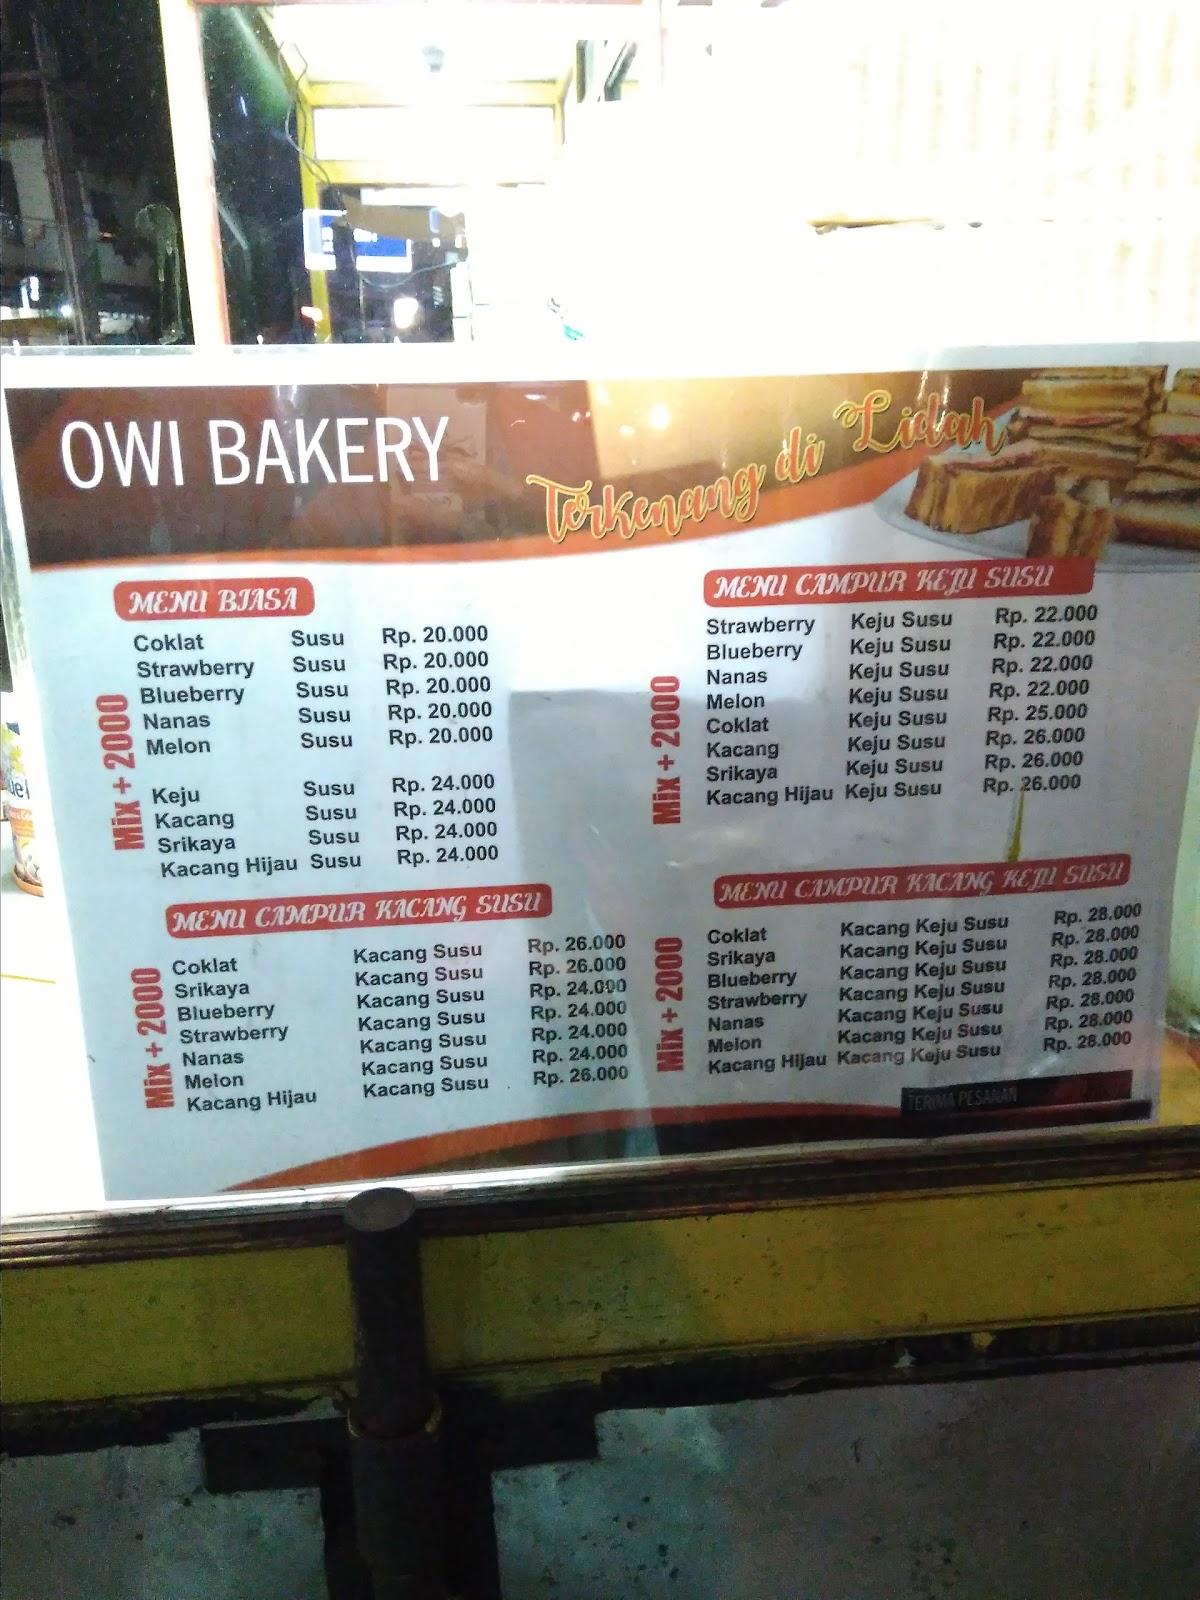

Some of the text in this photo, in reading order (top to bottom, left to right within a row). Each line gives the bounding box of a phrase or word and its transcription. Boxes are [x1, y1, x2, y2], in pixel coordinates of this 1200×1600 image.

[62, 416, 449, 488] OWI BAKERY
[526, 390, 1008, 542] Terkenang di Lidah
[714, 565, 1055, 599] MENU CAMPUR KEJU SUSU
[129, 588, 298, 614] MENU BIASA
[133, 625, 488, 652] Coklat Susu Rp. 20.000
[706, 604, 1098, 636] Strawberry Keju Susu Rp. 22.000
[707, 629, 1096, 662] Blueberry Keju Susu Rp. 22.000
[136, 650, 489, 680] Strawberry Susu Rp. 20.000
[707, 654, 1093, 685] Nanas Keju Susu Rp. 22.000
[140, 675, 491, 706] Blueberry Susu Rp. 20.000
[706, 679, 1090, 710] Melon Keju Susu Rp. 22.000
[143, 701, 492, 730] Nanas Susu Rp. 20.000
[651, 676, 680, 747] 2000
[706, 702, 1088, 734] Coklat Keju Susu Rp. 25.000
[96, 694, 136, 770] 2000
[146, 726, 493, 756] Melon Susu Rp. 20.000
[706, 727, 1086, 760] Kacang Keju Susu Rp. 26.000
[706, 750, 1084, 784] Srikaya Keju Susu Rp. 26.000
[152, 773, 495, 808] Keju Susu Rp. 24.000
[653, 777, 680, 824] Mix
[706, 773, 1082, 807] Kacang Hijau Keju Susu Rp. 26.000
[112, 800, 145, 850] Mix
[154, 797, 496, 830] Kacang Susu Rp. 24.000
[157, 821, 498, 855] Srikaya Susu Rp. 24.000
[160, 844, 499, 878] Kacang Hijau Susu Rp. 24.000
[718, 862, 1124, 902] MENU CAMPUR KACANG KEJU SUSU
[172, 892, 542, 932] MENU CAMPUR KACANG SUSU
[707, 902, 1142, 945] Coklat Kacang Keju Susu Rp. 28.000
[172, 933, 626, 976] Coklat Kacang Susu Rp. 26.000
[707, 924, 1140, 968] Srikaya Kacang Keju Susu Rp. 28.000
[655, 937, 683, 1002] 2000
[131, 968, 167, 1035] 2000
[707, 967, 1137, 1011] Strawberry Kacang Keju Susu Rp. 28.000
[179, 1000, 627, 1045] Strawberry Kacang Susu Rp. 24.000
[184, 1043, 628, 1090] Melon Kacang Susu Rp. 24.000
[656, 1028, 684, 1072] Mix
[144, 1063, 175, 1108] Mix
[187, 1065, 629, 1112] Kacang Hijau Kacang Susu Rp. 26.000
